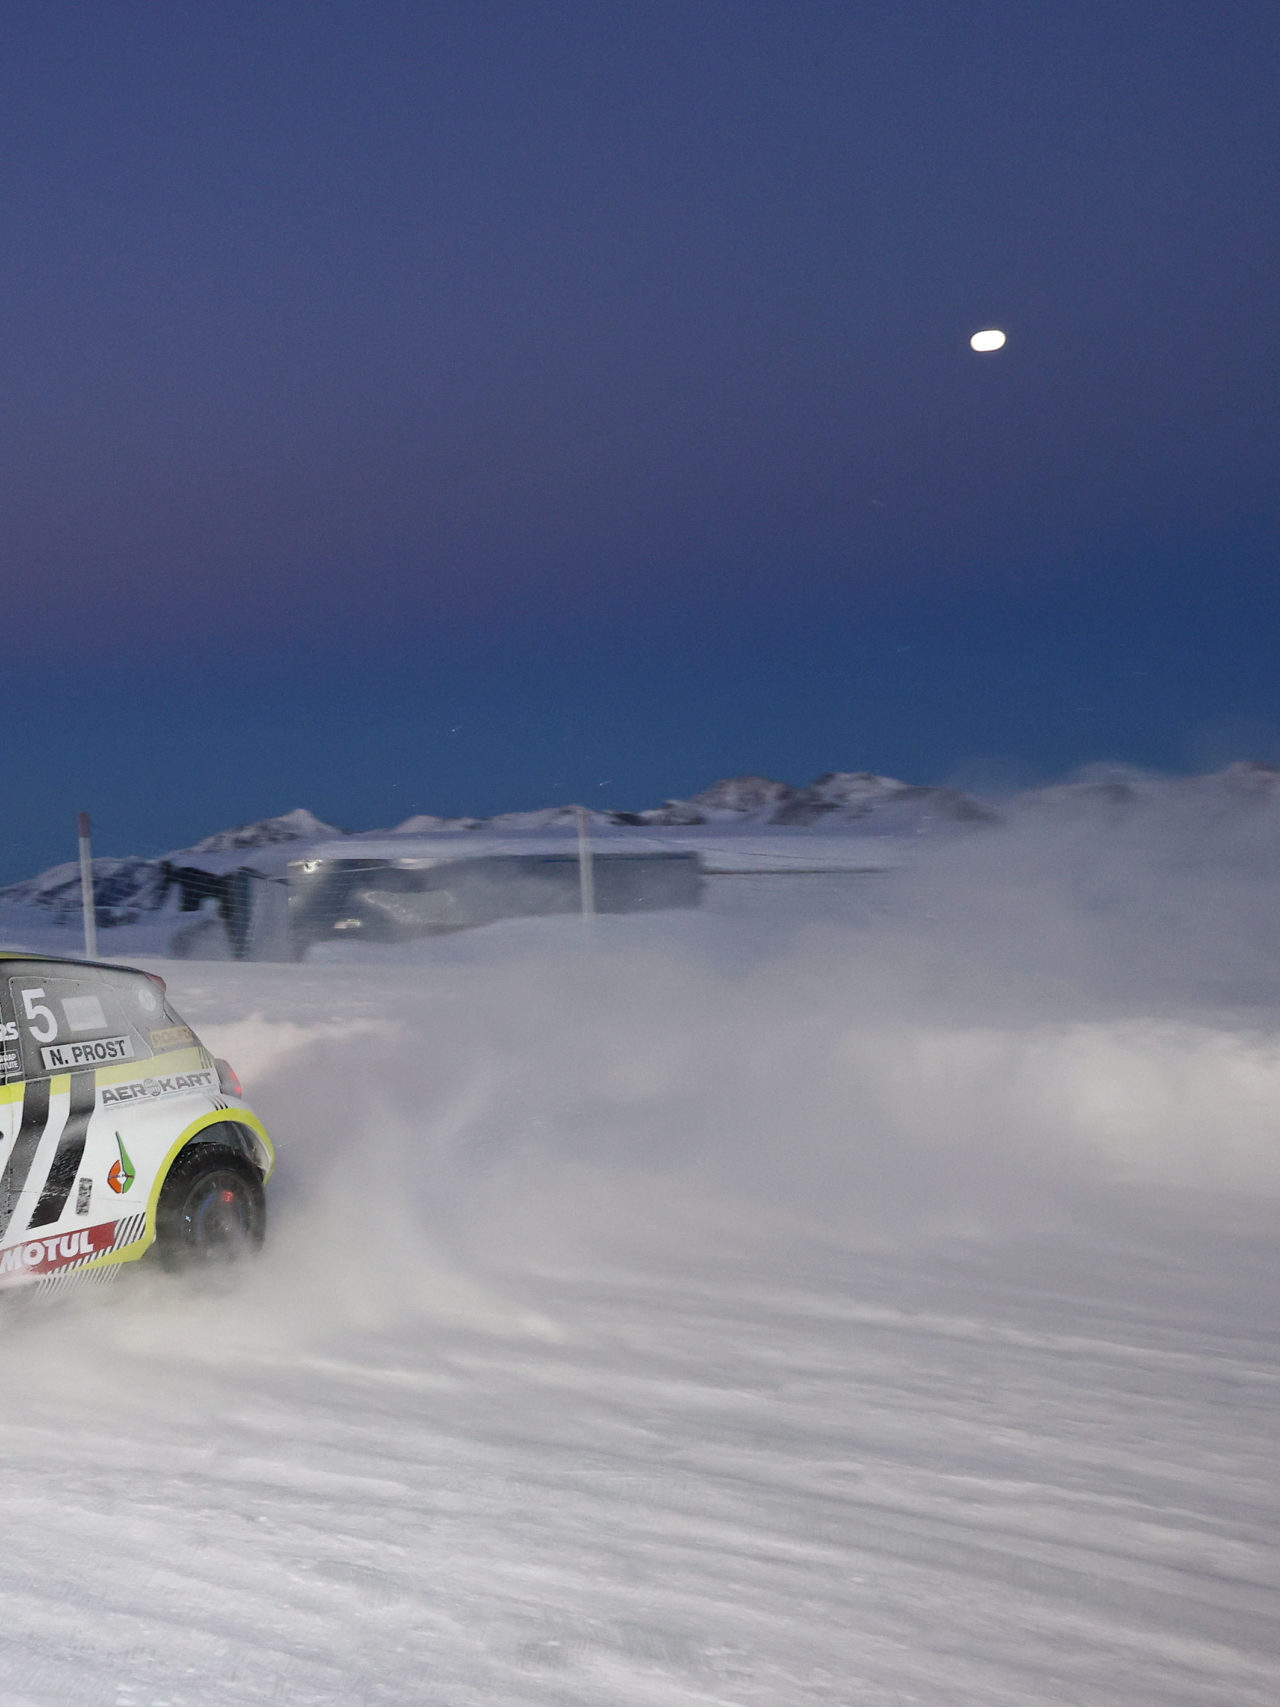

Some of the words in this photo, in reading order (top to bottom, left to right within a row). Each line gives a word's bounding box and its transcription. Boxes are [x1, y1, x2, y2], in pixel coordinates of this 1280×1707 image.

[22, 988, 58, 1043] 5
[50, 1049, 69, 1067] N.
[72, 1039, 126, 1063] PROST
[0, 1230, 95, 1274] MOTUL
